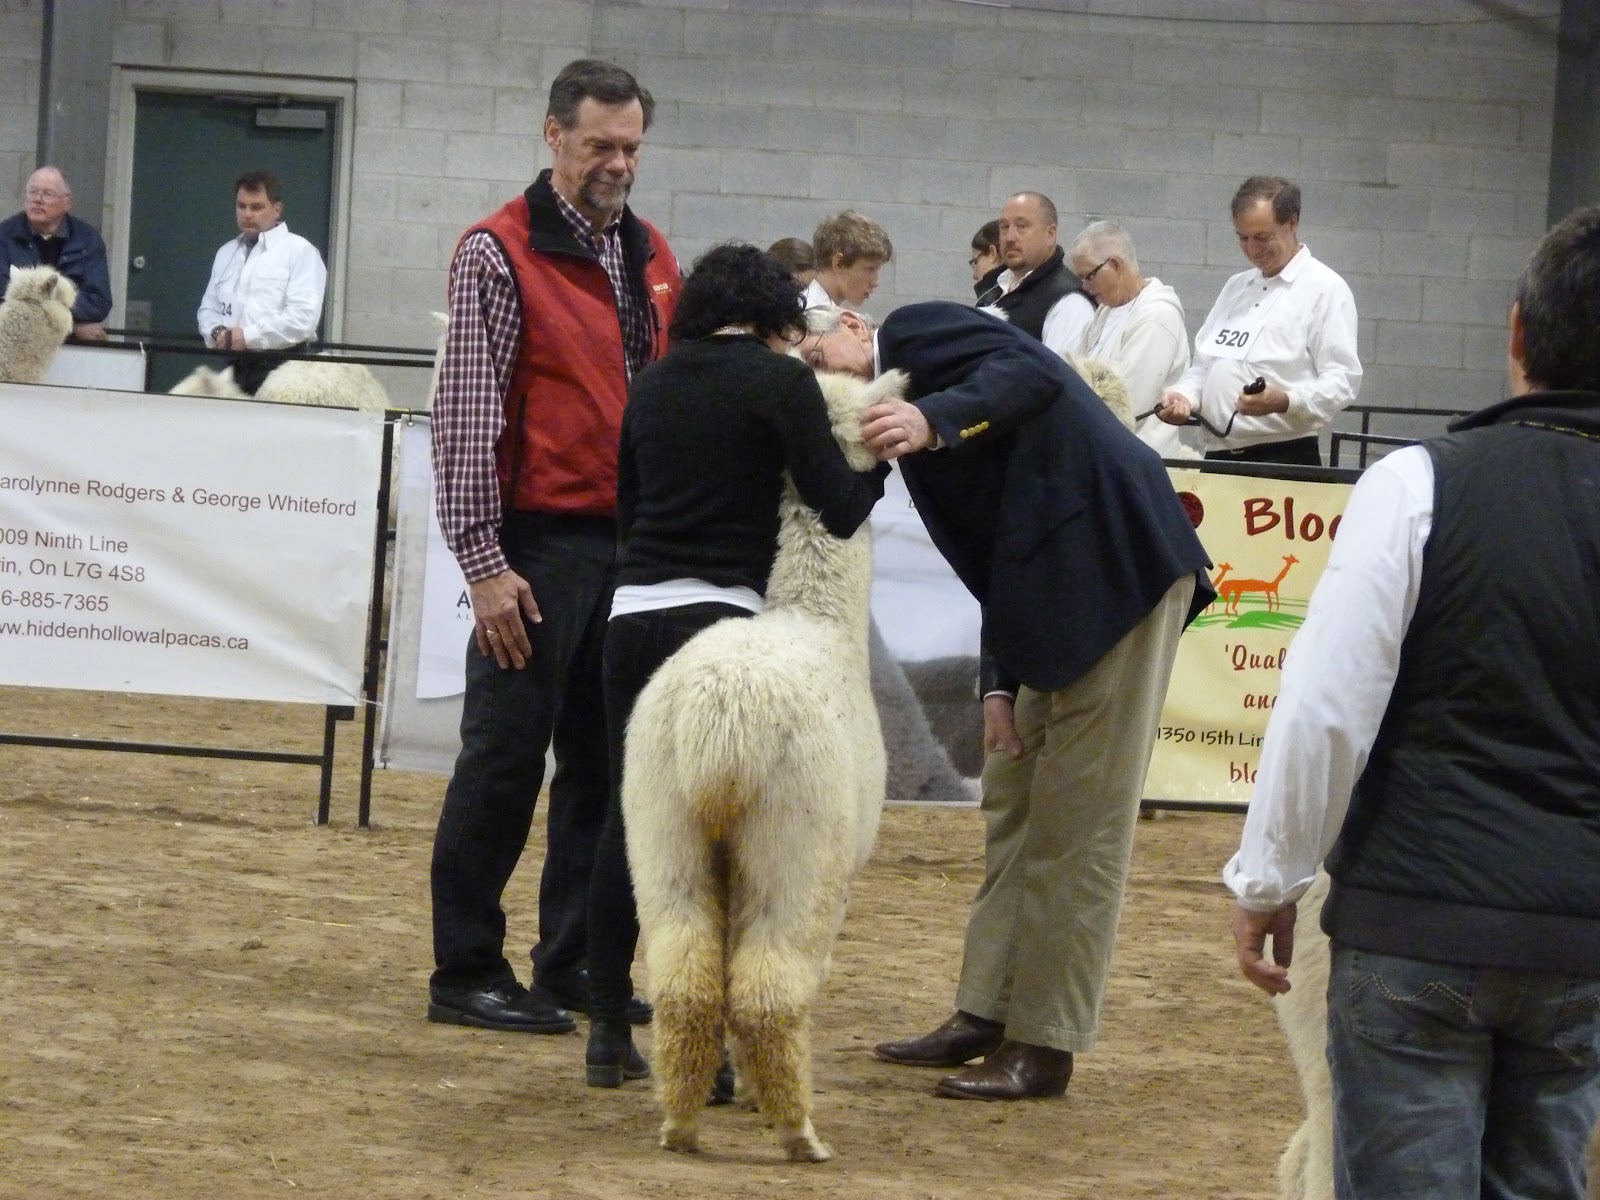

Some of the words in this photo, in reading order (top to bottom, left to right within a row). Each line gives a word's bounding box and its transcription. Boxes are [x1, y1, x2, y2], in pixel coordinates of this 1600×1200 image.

[1215, 328, 1250, 348] 520
[0, 475, 81, 496] arolynne
[87, 480, 166, 504] Rodgers
[172, 486, 186, 503] &
[192, 488, 262, 512] George
[267, 493, 357, 516] Whiteford
[35, 531, 83, 551] Ninth
[89, 535, 129, 554] Line
[29, 558, 57, 576] On
[63, 561, 102, 579] L7G
[108, 565, 146, 582] 4S8
[1, 589, 109, 612] 6-885-7365
[1243, 693, 1278, 710] an
[1157, 727, 1196, 743] 1350
[1201, 729, 1234, 746] 15th
